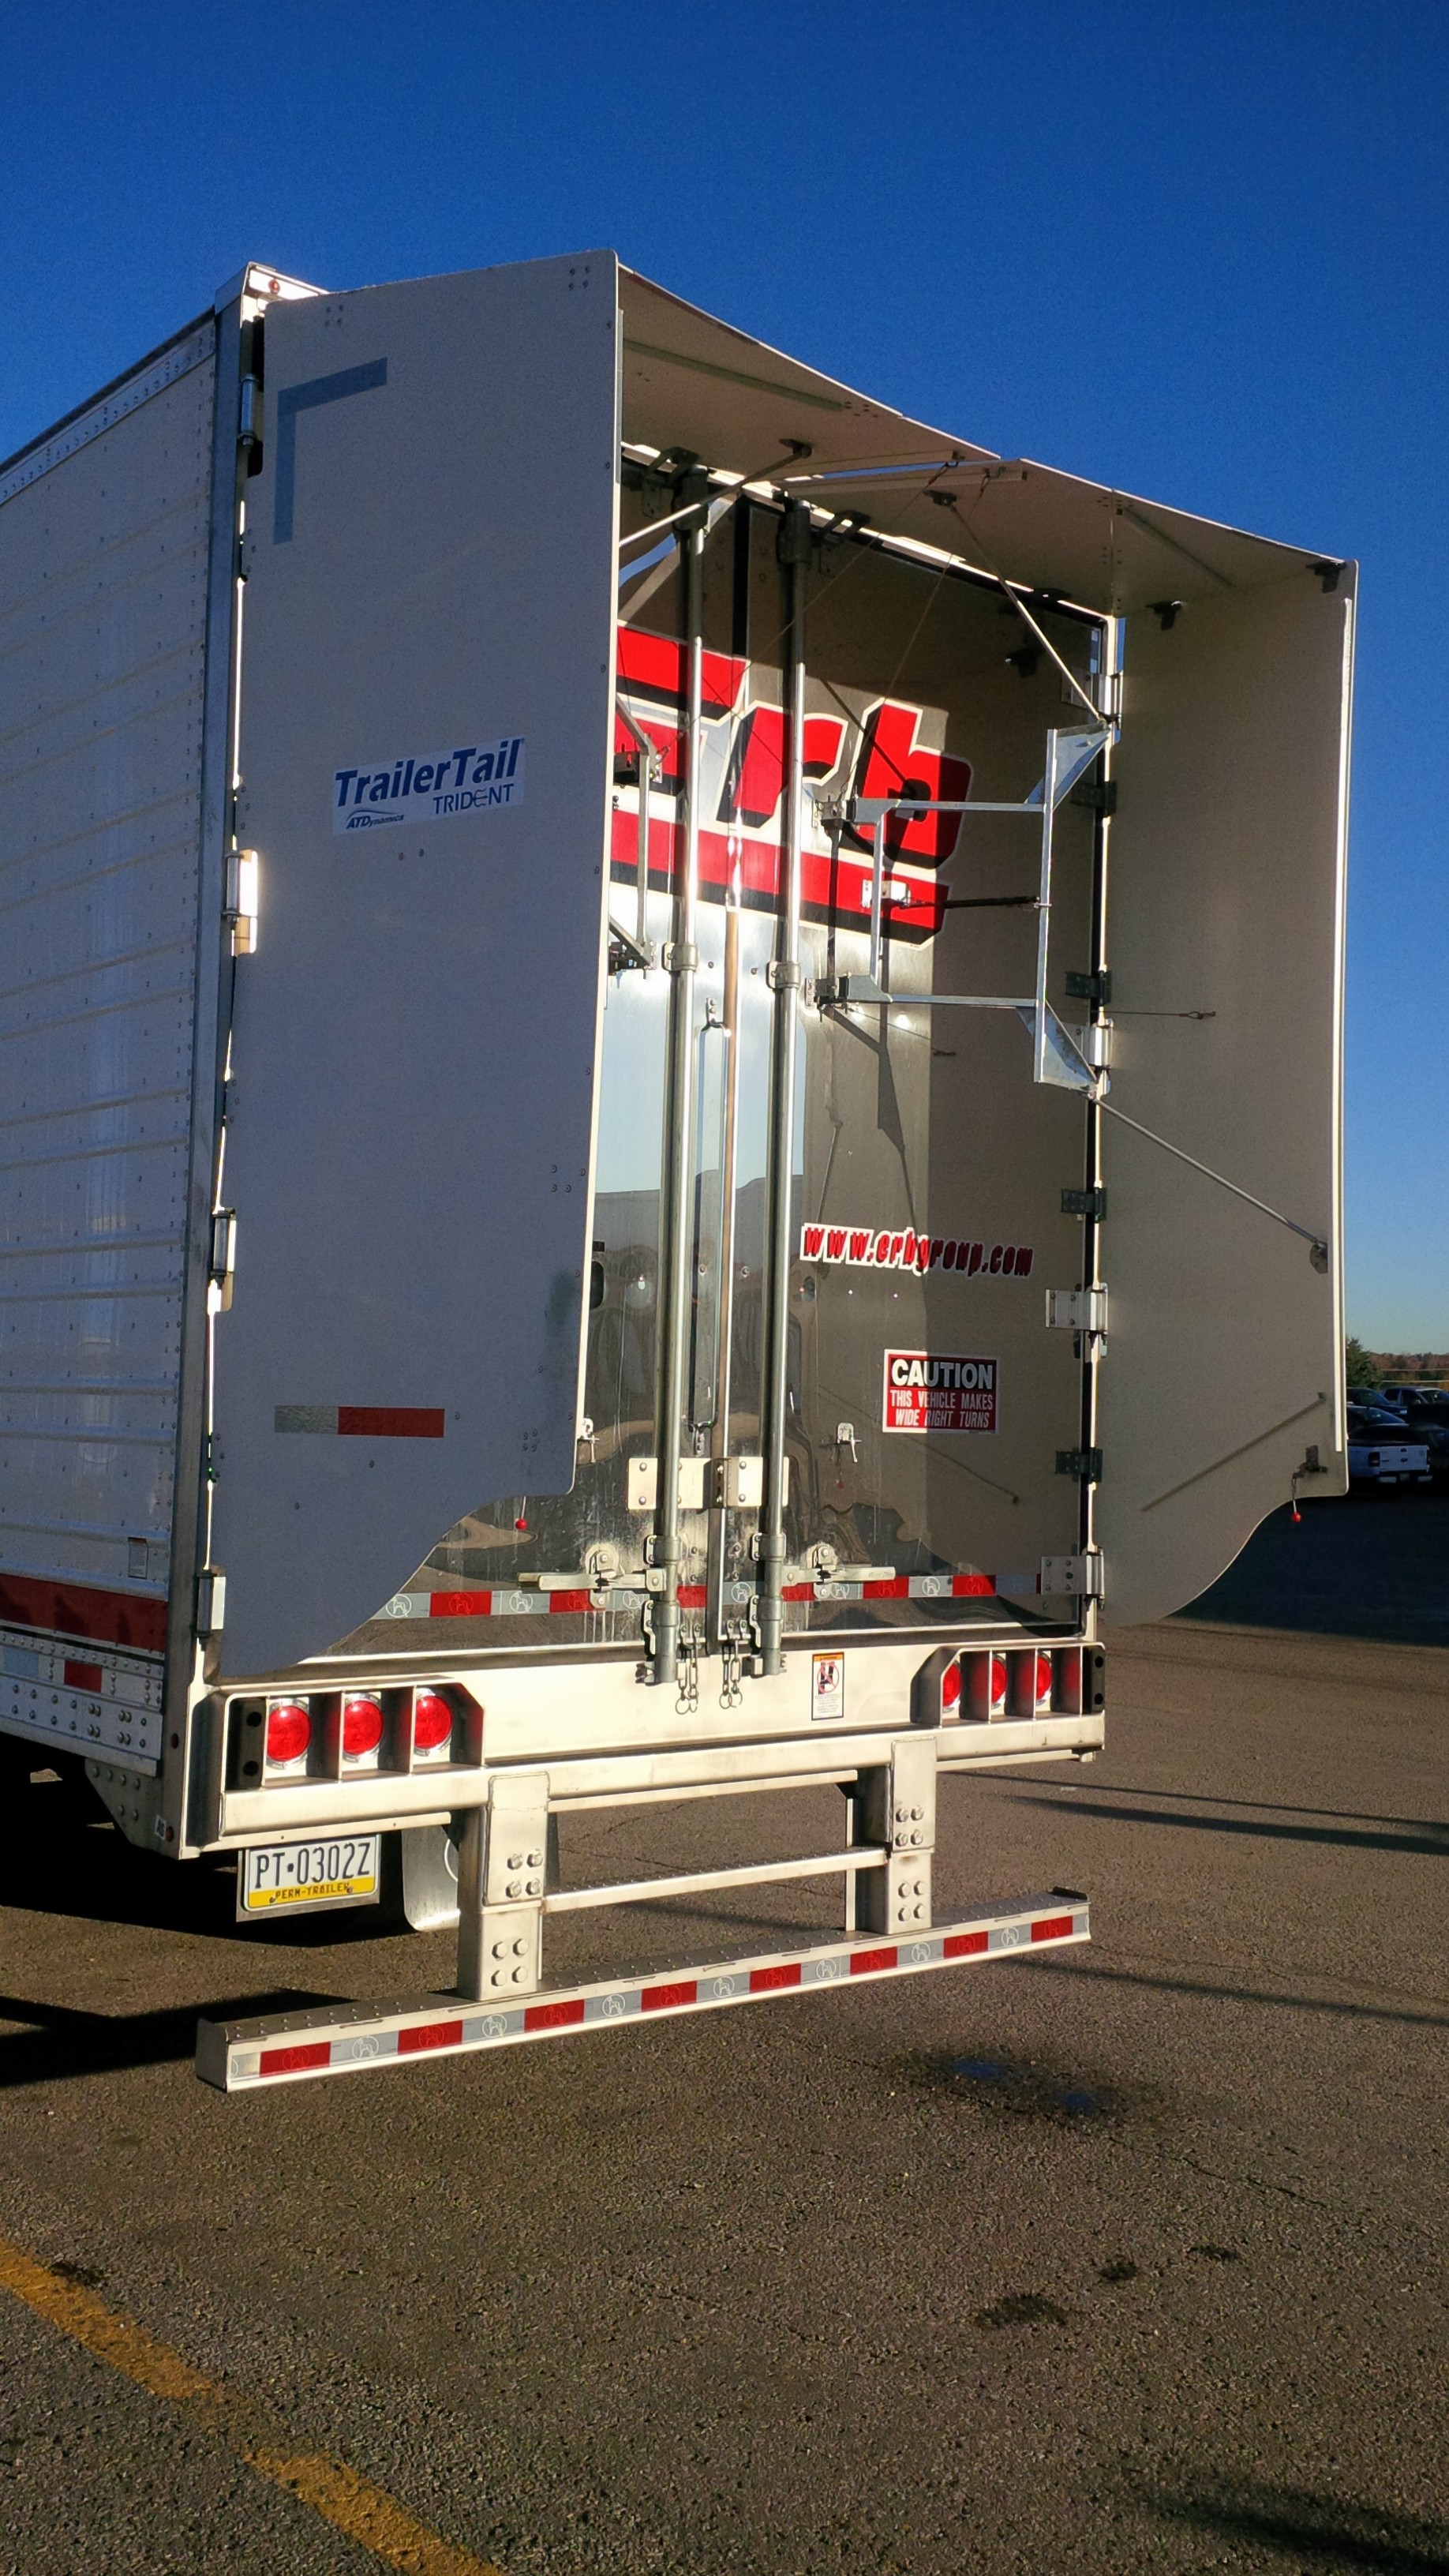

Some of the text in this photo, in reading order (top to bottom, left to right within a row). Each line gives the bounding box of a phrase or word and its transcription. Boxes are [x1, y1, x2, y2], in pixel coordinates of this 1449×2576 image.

[335, 738, 523, 808] TrailerTail
[432, 783, 515, 815] TRIDENT
[802, 1225, 1033, 1277] www.erbgroup.com
[891, 1359, 993, 1389] CAUTION
[890, 1389, 993, 1410] THIS VEHICLE MAKES
[895, 1408, 990, 1428] WIDE RIGHT TURNS
